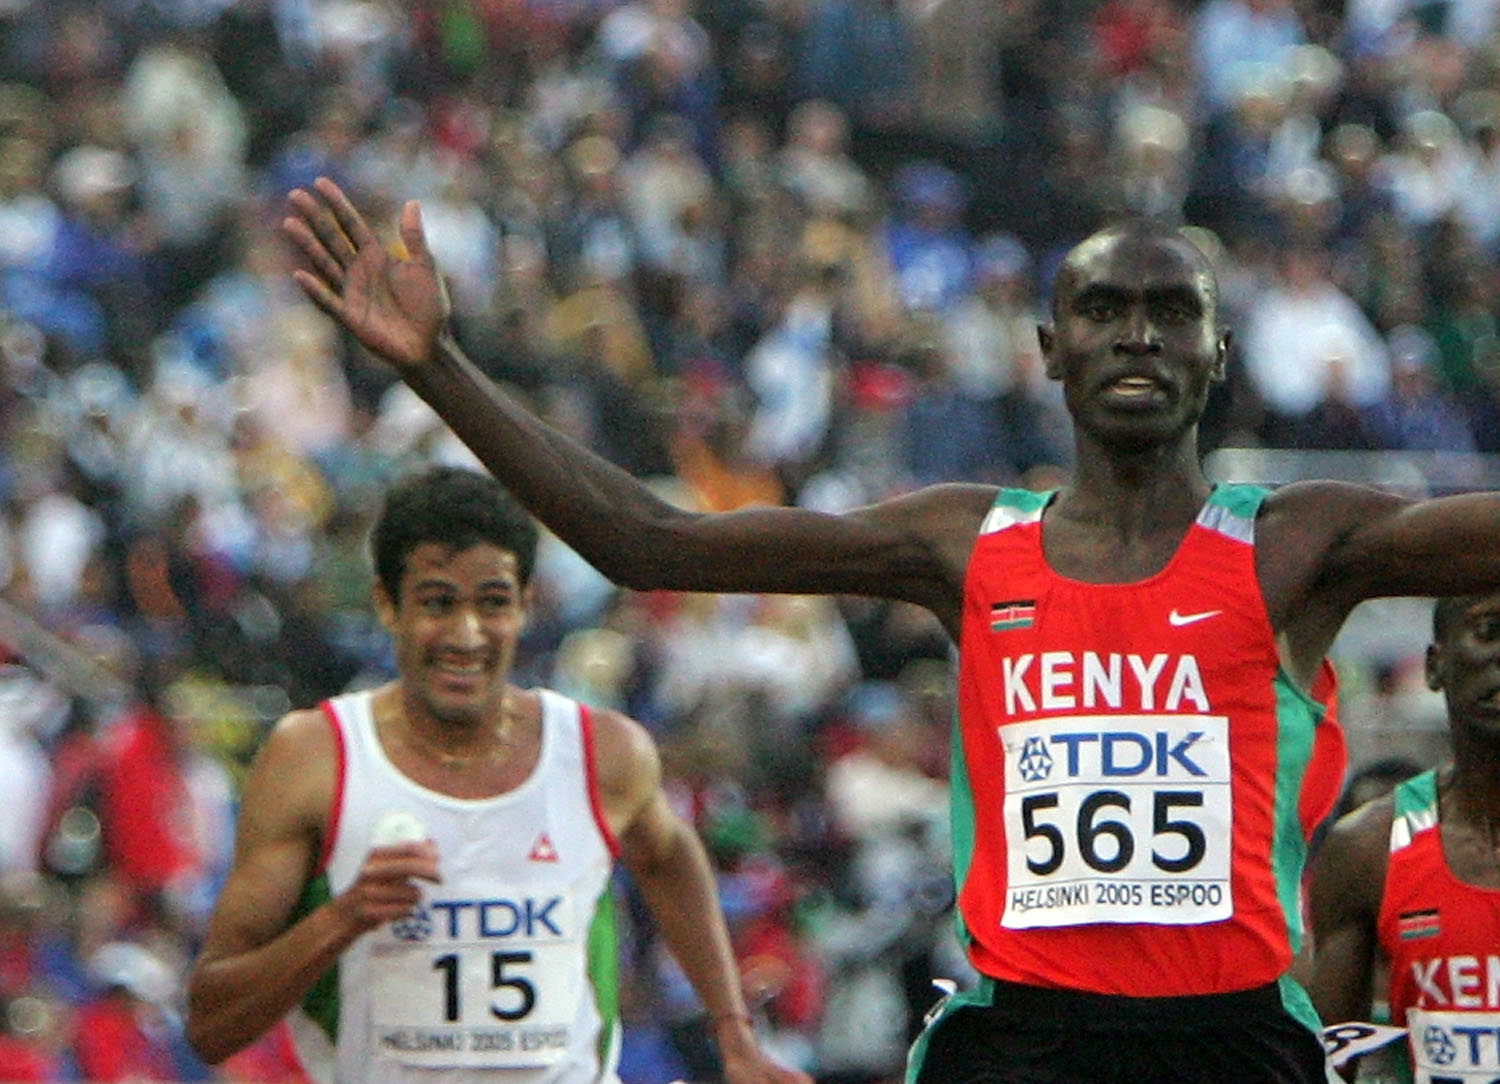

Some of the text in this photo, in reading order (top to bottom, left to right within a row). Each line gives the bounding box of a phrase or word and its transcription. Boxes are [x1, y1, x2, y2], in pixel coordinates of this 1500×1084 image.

[1003, 652, 1210, 715] KENYA
[1051, 731, 1209, 777] TDK
[1020, 789, 1207, 877] 565
[431, 896, 563, 938] TDK
[1012, 884, 1222, 912] HELSINKI 2005 ESPOO
[432, 949, 536, 1021] 15
